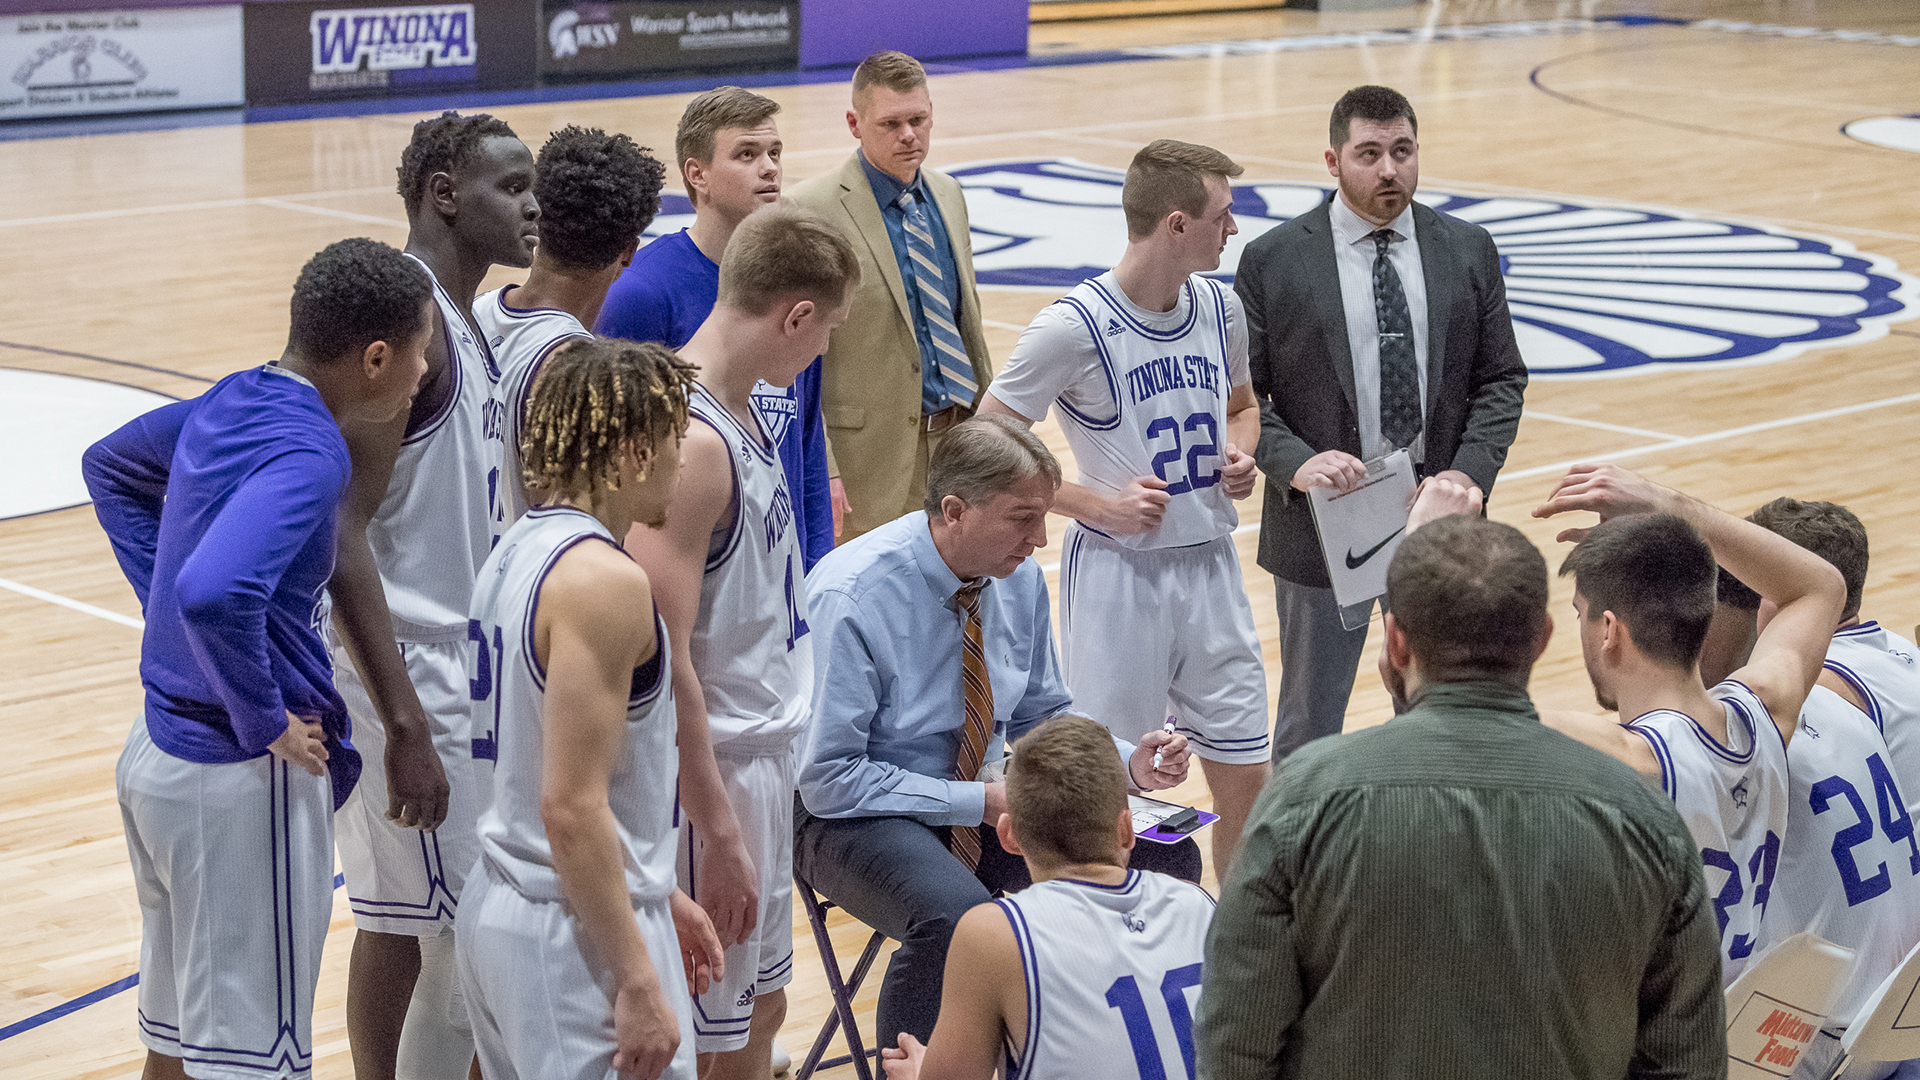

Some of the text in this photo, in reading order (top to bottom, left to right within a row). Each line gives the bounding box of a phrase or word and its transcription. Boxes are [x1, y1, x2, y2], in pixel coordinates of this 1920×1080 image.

[317, 11, 470, 66] WINONA
[1107, 326, 1127, 338] adidas
[761, 396, 796, 414] STATE
[1146, 412, 1222, 496] 22
[1809, 752, 1920, 908] 24
[1754, 1036, 1800, 1068] Foods
